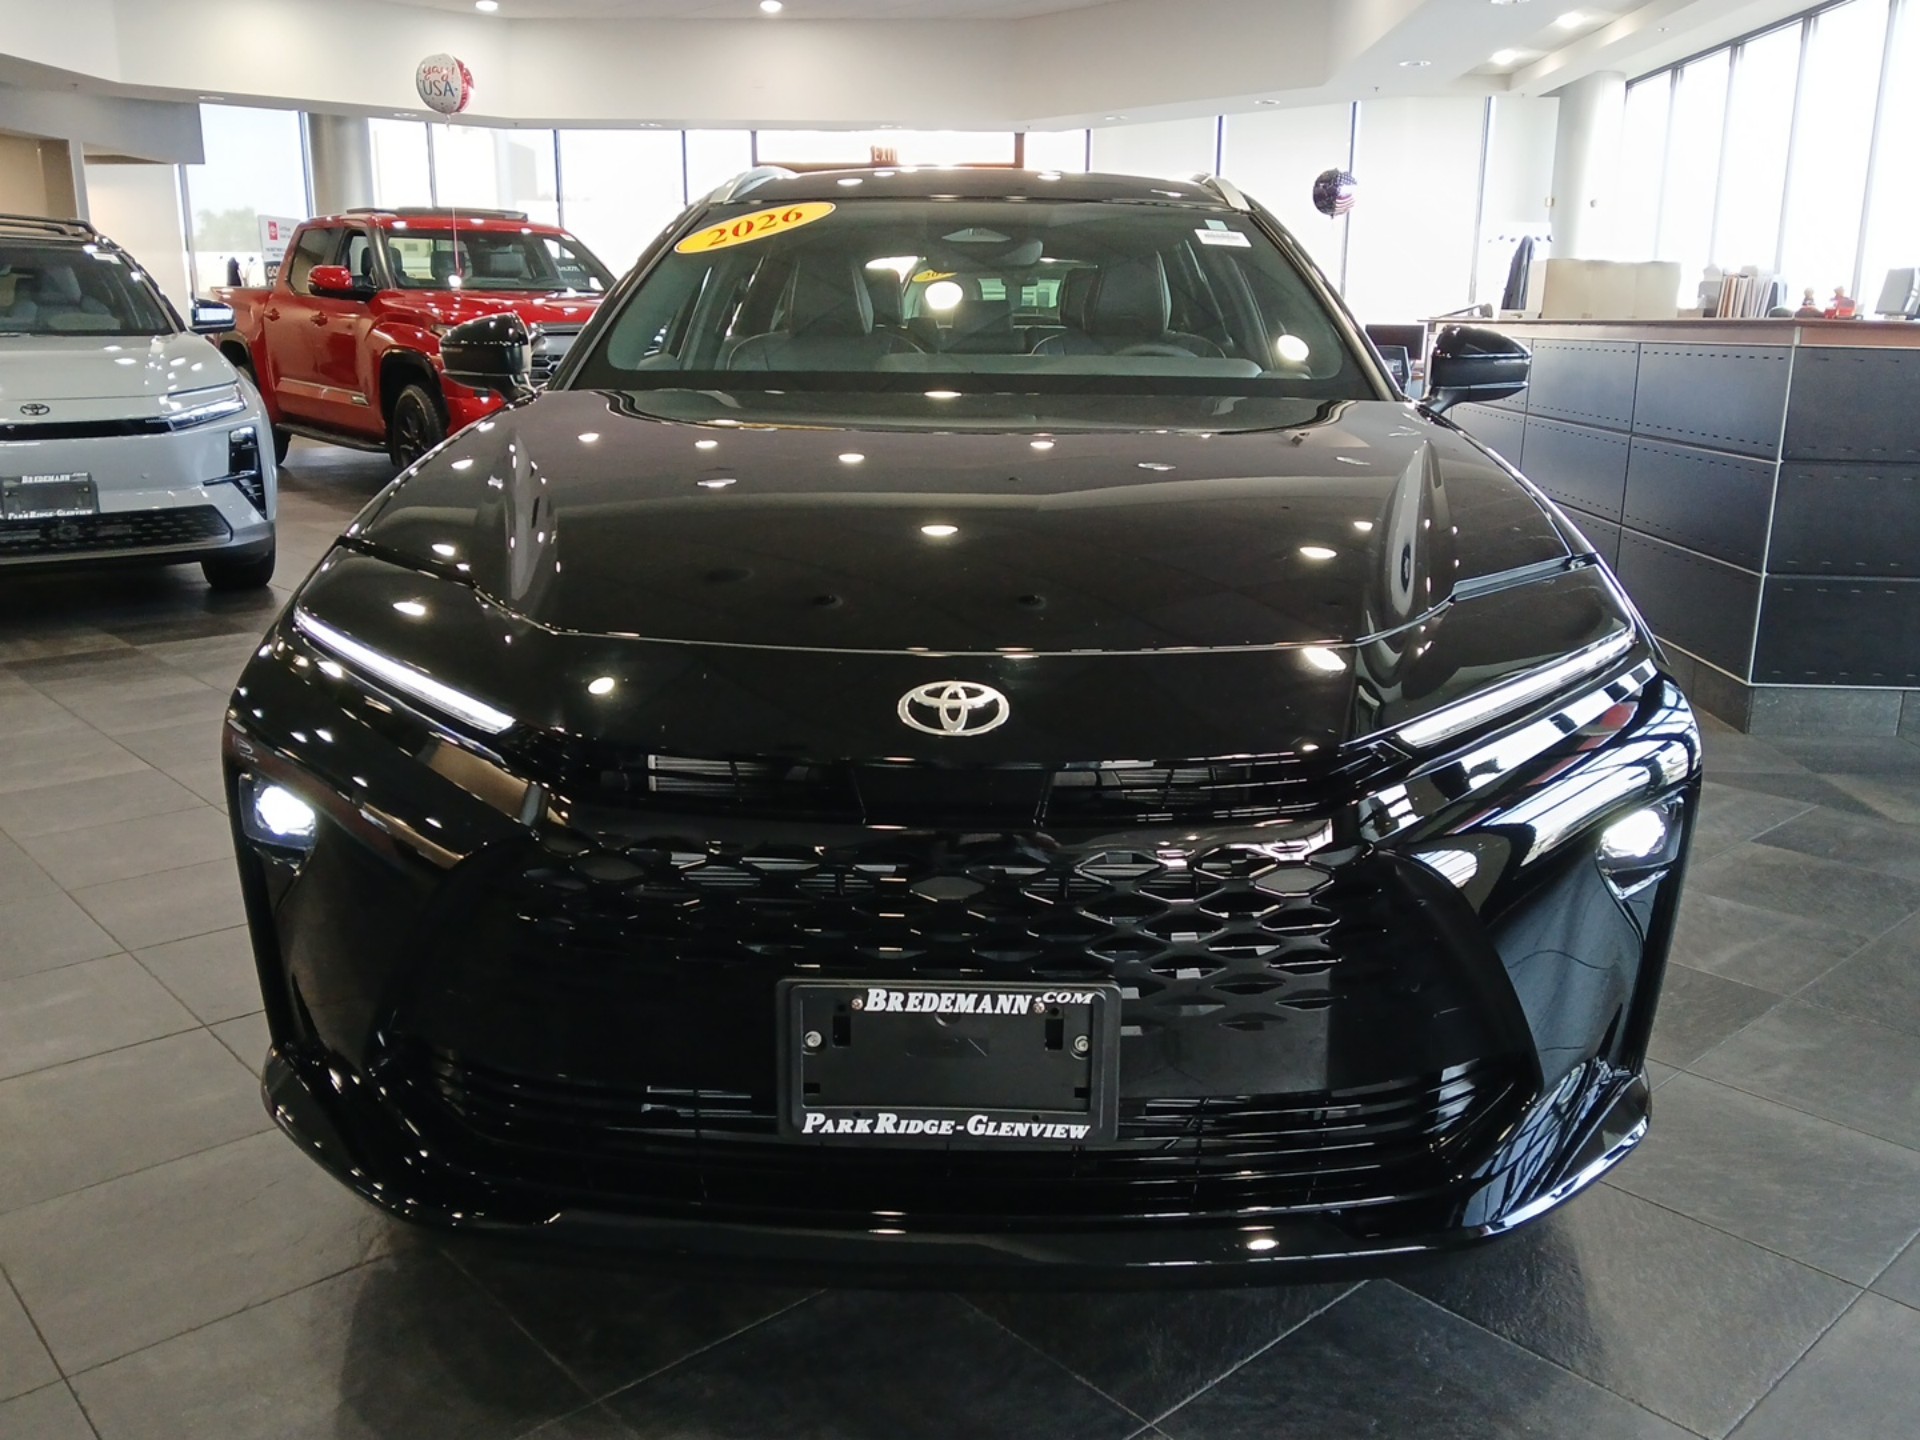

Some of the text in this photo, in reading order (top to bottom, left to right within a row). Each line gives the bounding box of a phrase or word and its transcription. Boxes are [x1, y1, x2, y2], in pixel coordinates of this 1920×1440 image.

[422, 79, 455, 97] USA
[708, 207, 803, 247] 2026
[801, 1112, 874, 1134] PARK
